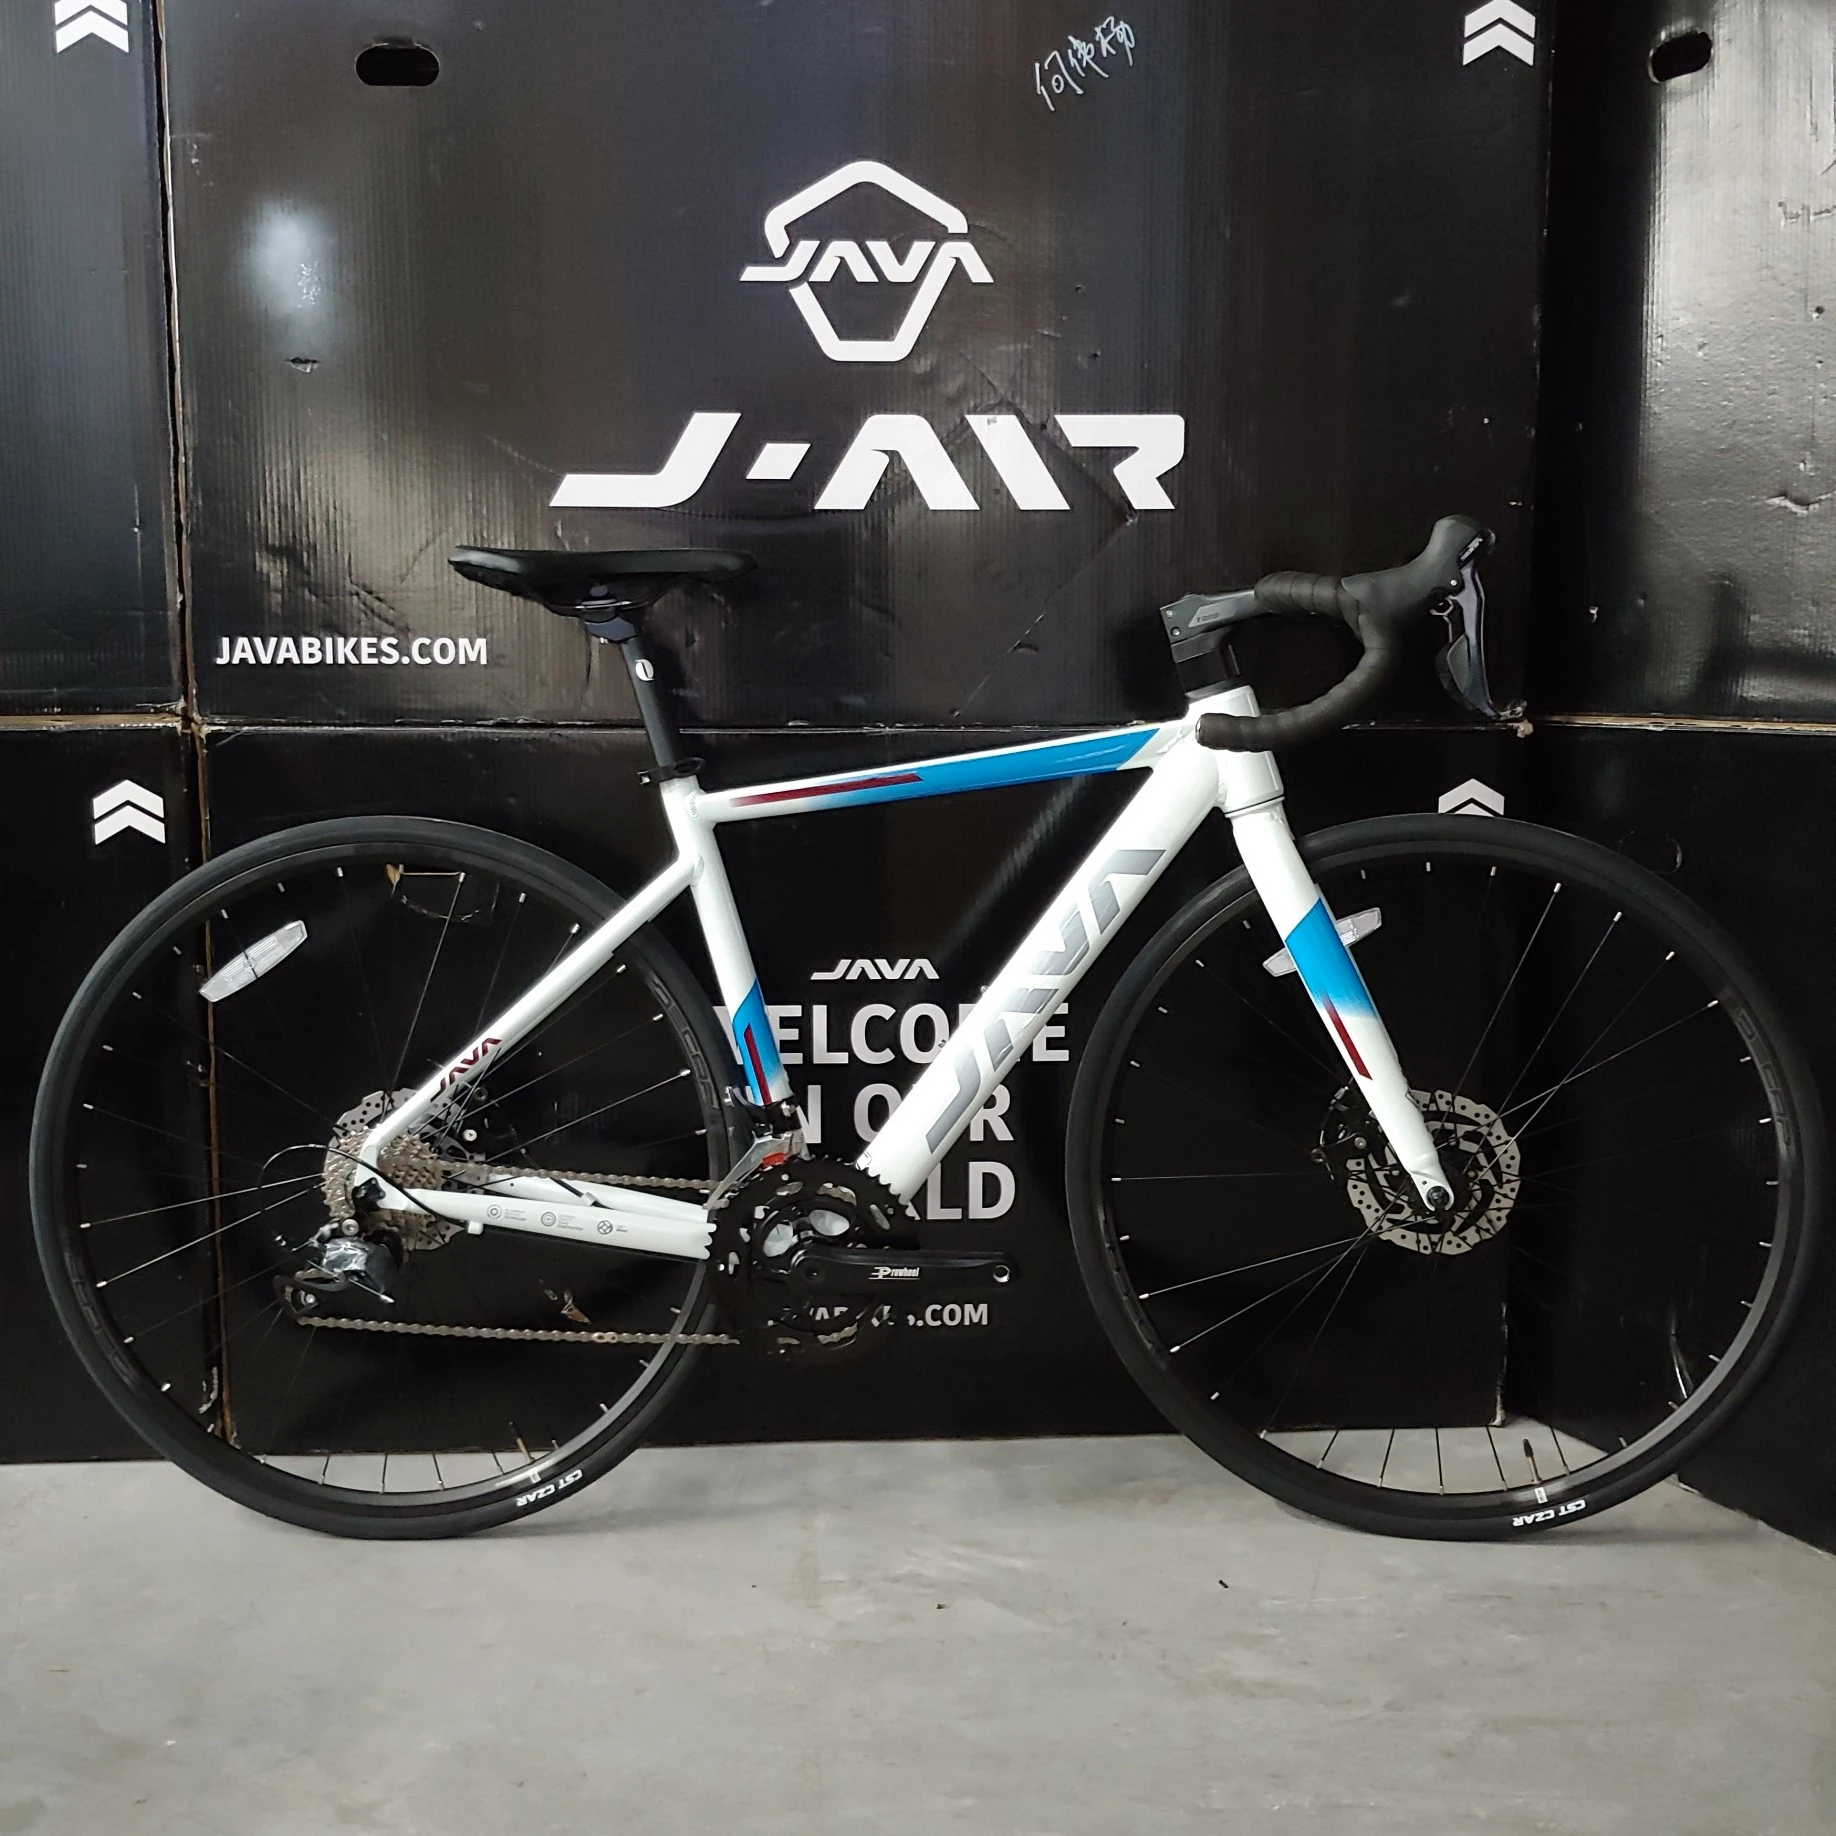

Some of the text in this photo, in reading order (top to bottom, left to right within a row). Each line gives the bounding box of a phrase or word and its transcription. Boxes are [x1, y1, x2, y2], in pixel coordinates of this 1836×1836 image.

[739, 240, 994, 283] JAVA
[215, 636, 488, 665] JAVABIKES.COM
[810, 958, 940, 980] JAVA
[925, 849, 1167, 1154] JAVA
[713, 1003, 1070, 1065] ELCOE
[429, 1037, 502, 1103] JAVA
[853, 1083, 1015, 1142] OR
[1512, 1499, 1586, 1527] CST CZAR
